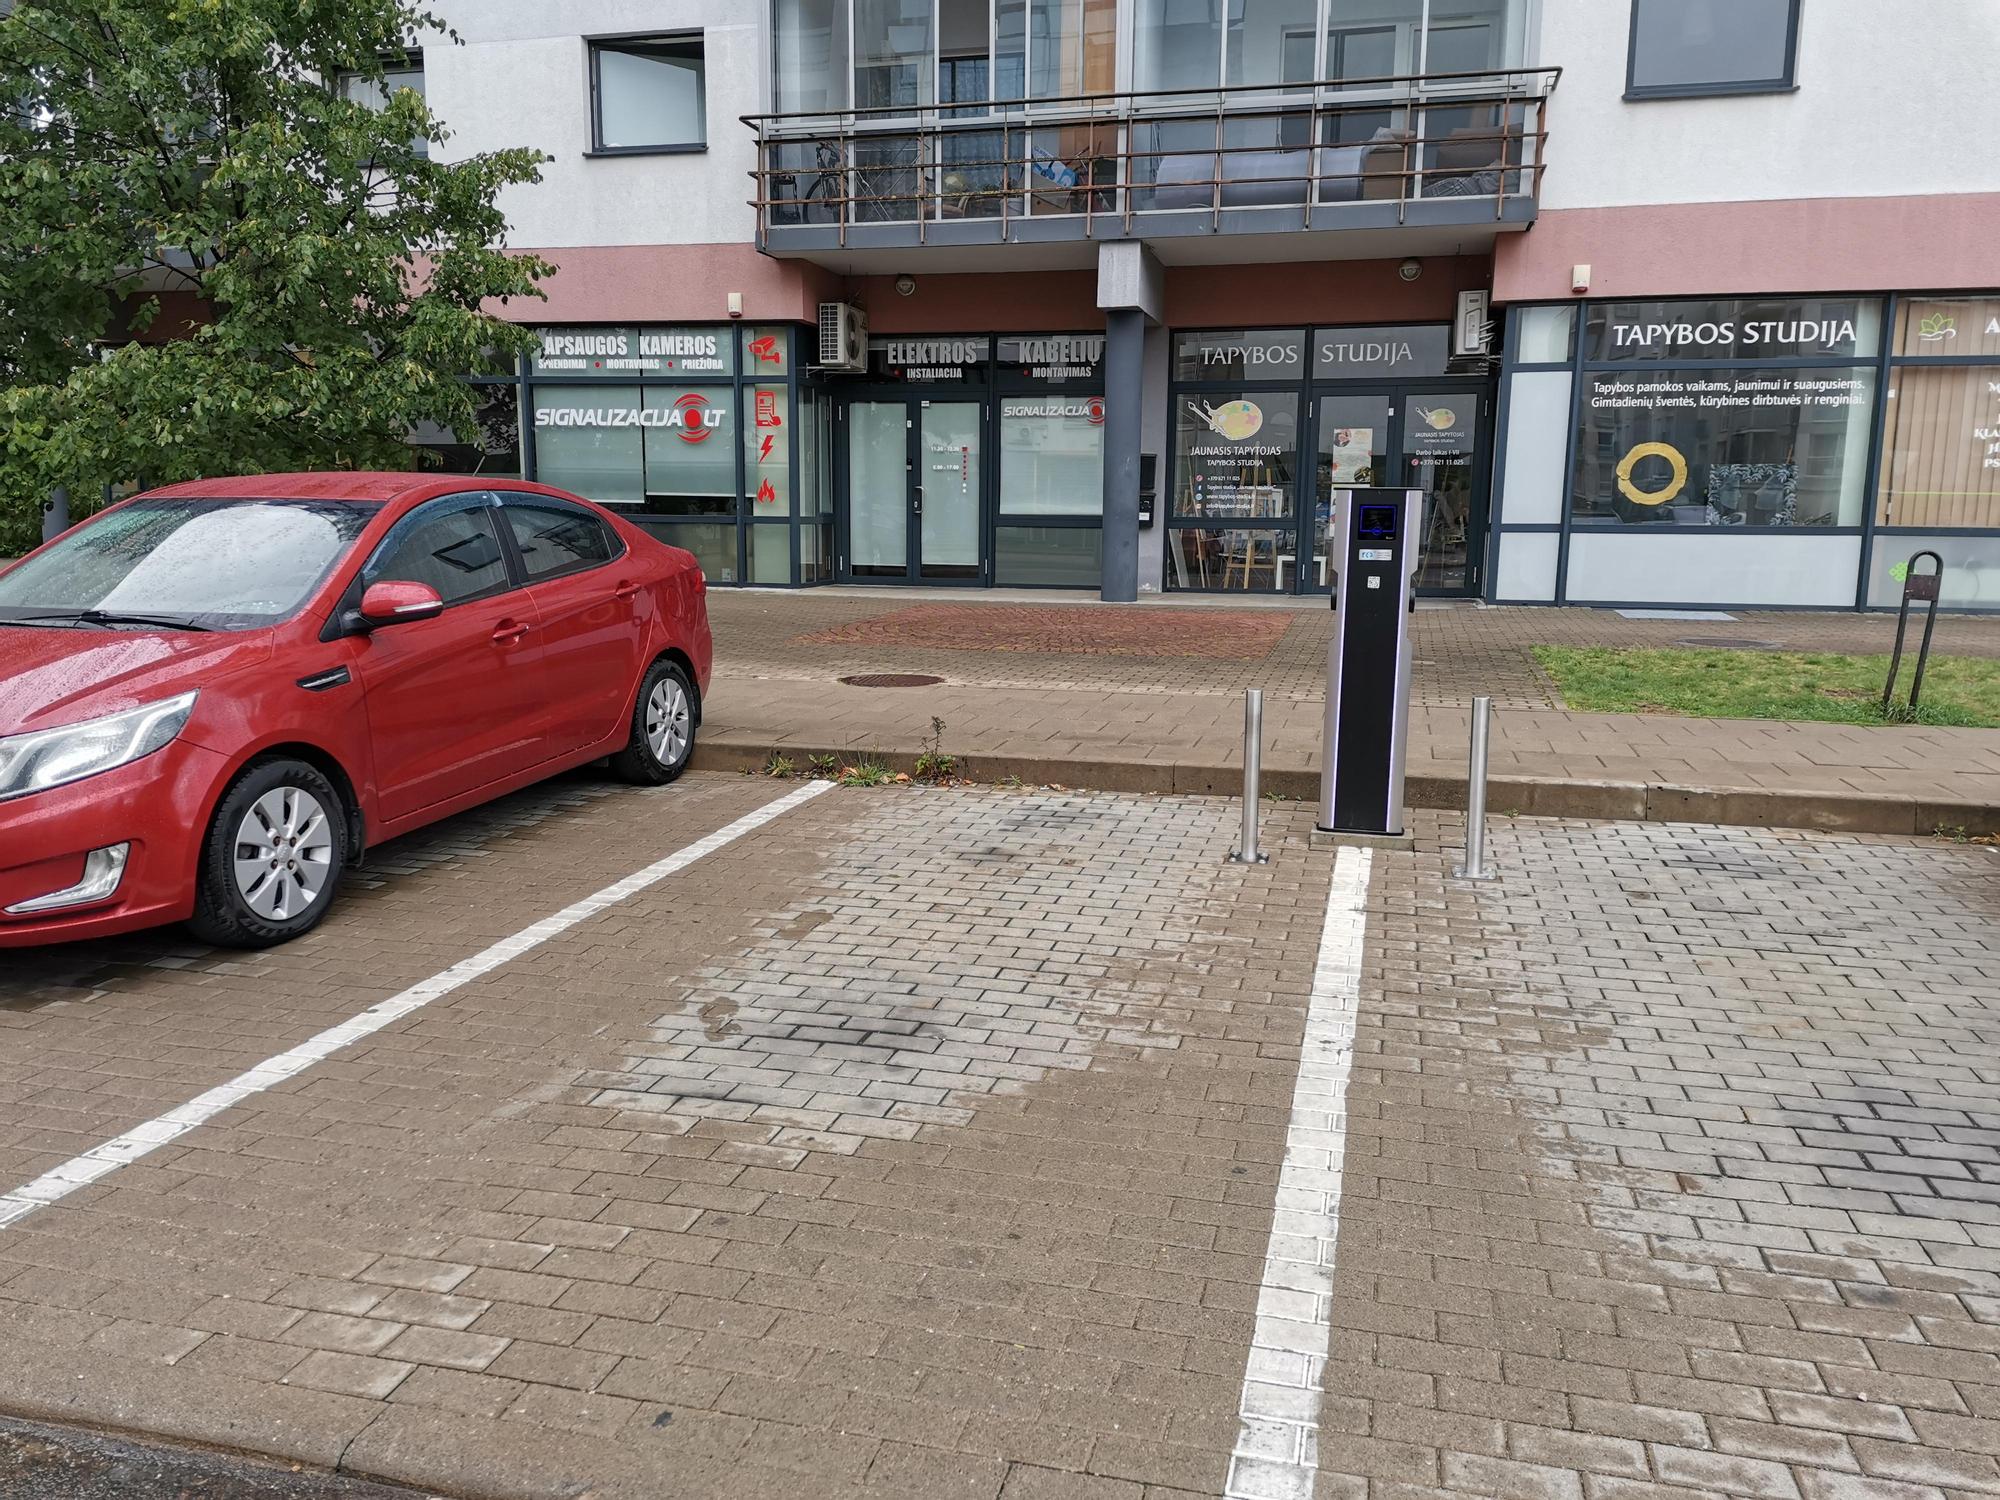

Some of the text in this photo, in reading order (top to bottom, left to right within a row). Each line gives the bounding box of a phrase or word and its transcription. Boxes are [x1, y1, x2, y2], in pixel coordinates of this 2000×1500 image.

[1613, 320, 1857, 347] TAPYBOS STUDIJA
[544, 336, 716, 356] APSAUGOS KAMEROS
[887, 340, 1100, 366] ELEKTROS KABELIŲ
[1201, 342, 1413, 366] TAPYBOS STUDIJA
[606, 358, 660, 369] MONTAVIMAS
[681, 357, 723, 370] PRIEŽIŪRA
[906, 367, 962, 378] INSTALIACIJA
[1032, 366, 1091, 378] MONTAVIMAS
[1594, 378, 1865, 395] Tapybos pamokos vaikams, jaunimui ir suaugusiems.
[1591, 393, 1865, 409] Gimtadienių šventės, kūrybines dirbtuvės ir renginiai.
[1003, 405, 1090, 417] SIGNALIZACIJA
[1190, 446, 1281, 456] JAUNASIS TAPYTOJAS
[1237, 459, 1264, 467] STUDIJA
